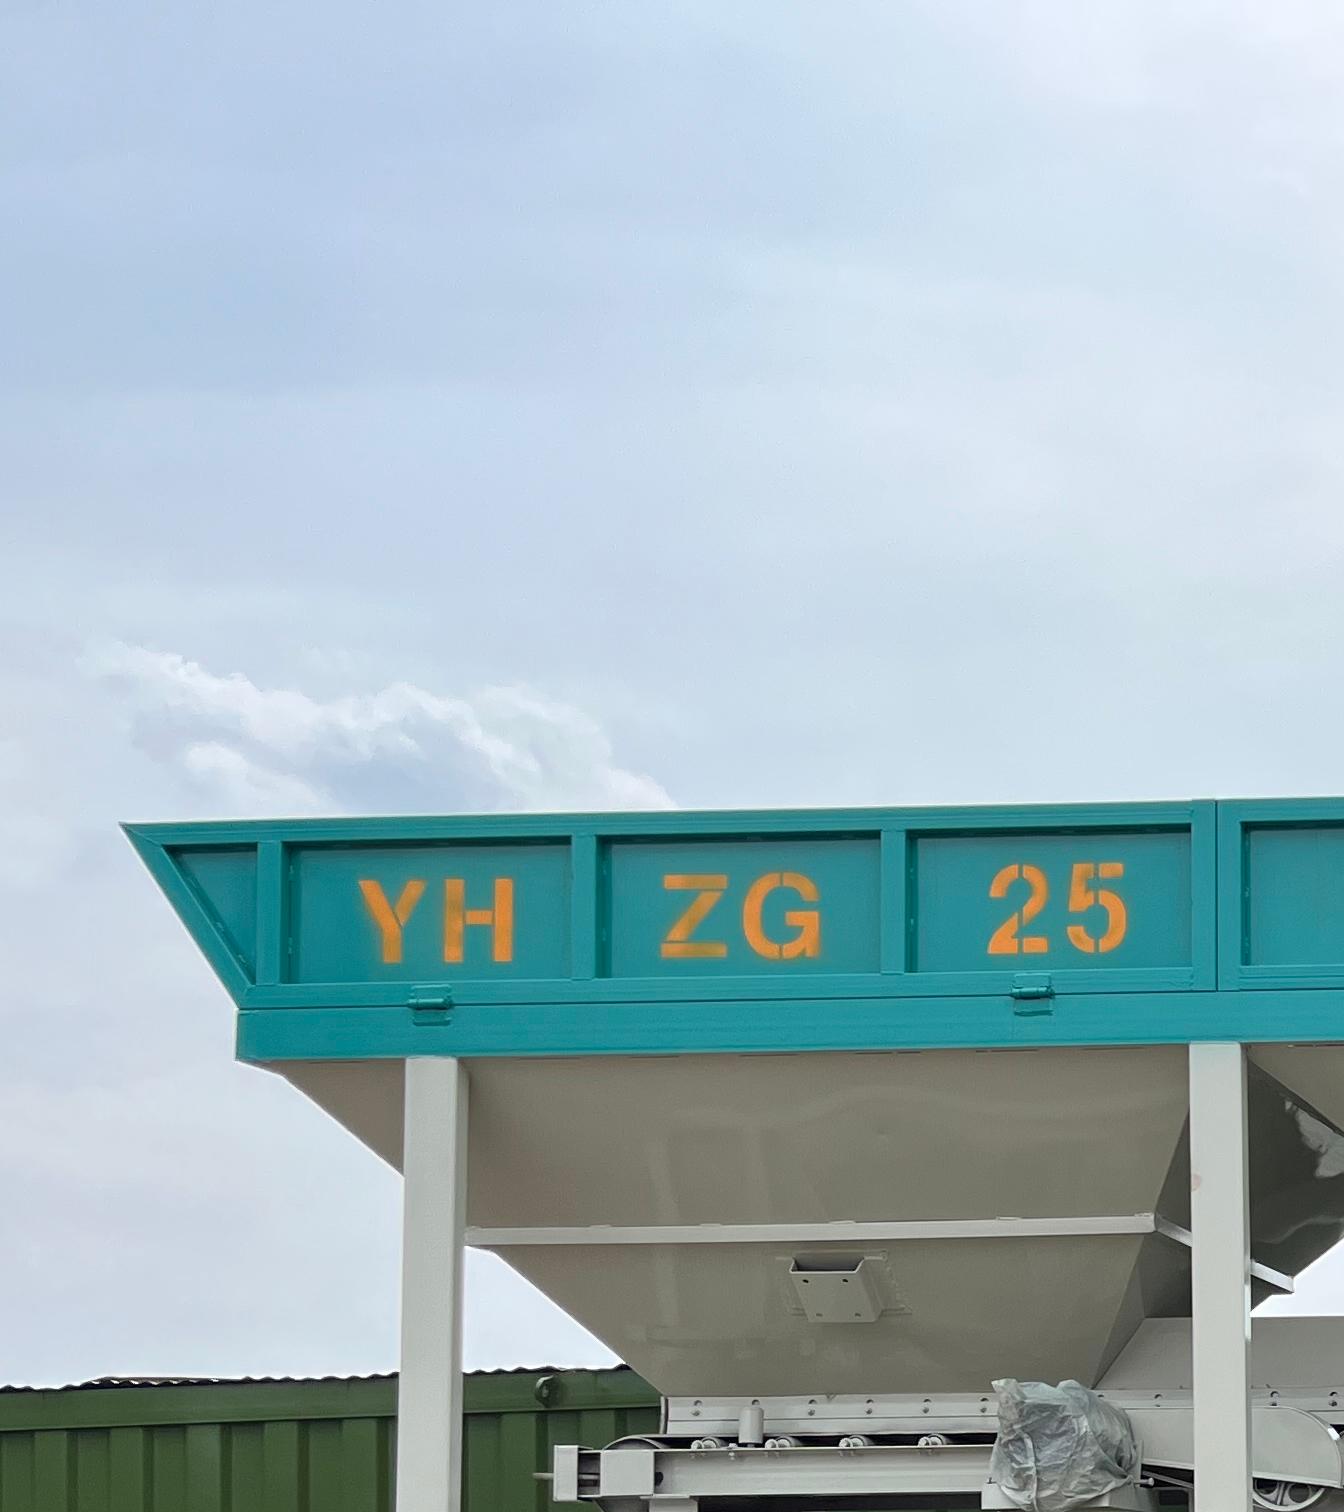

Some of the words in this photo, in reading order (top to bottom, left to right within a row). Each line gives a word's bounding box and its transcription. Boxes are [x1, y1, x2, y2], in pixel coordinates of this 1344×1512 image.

[357, 878, 514, 964] YH
[659, 872, 822, 961] ZG
[987, 863, 1127, 956] 25
